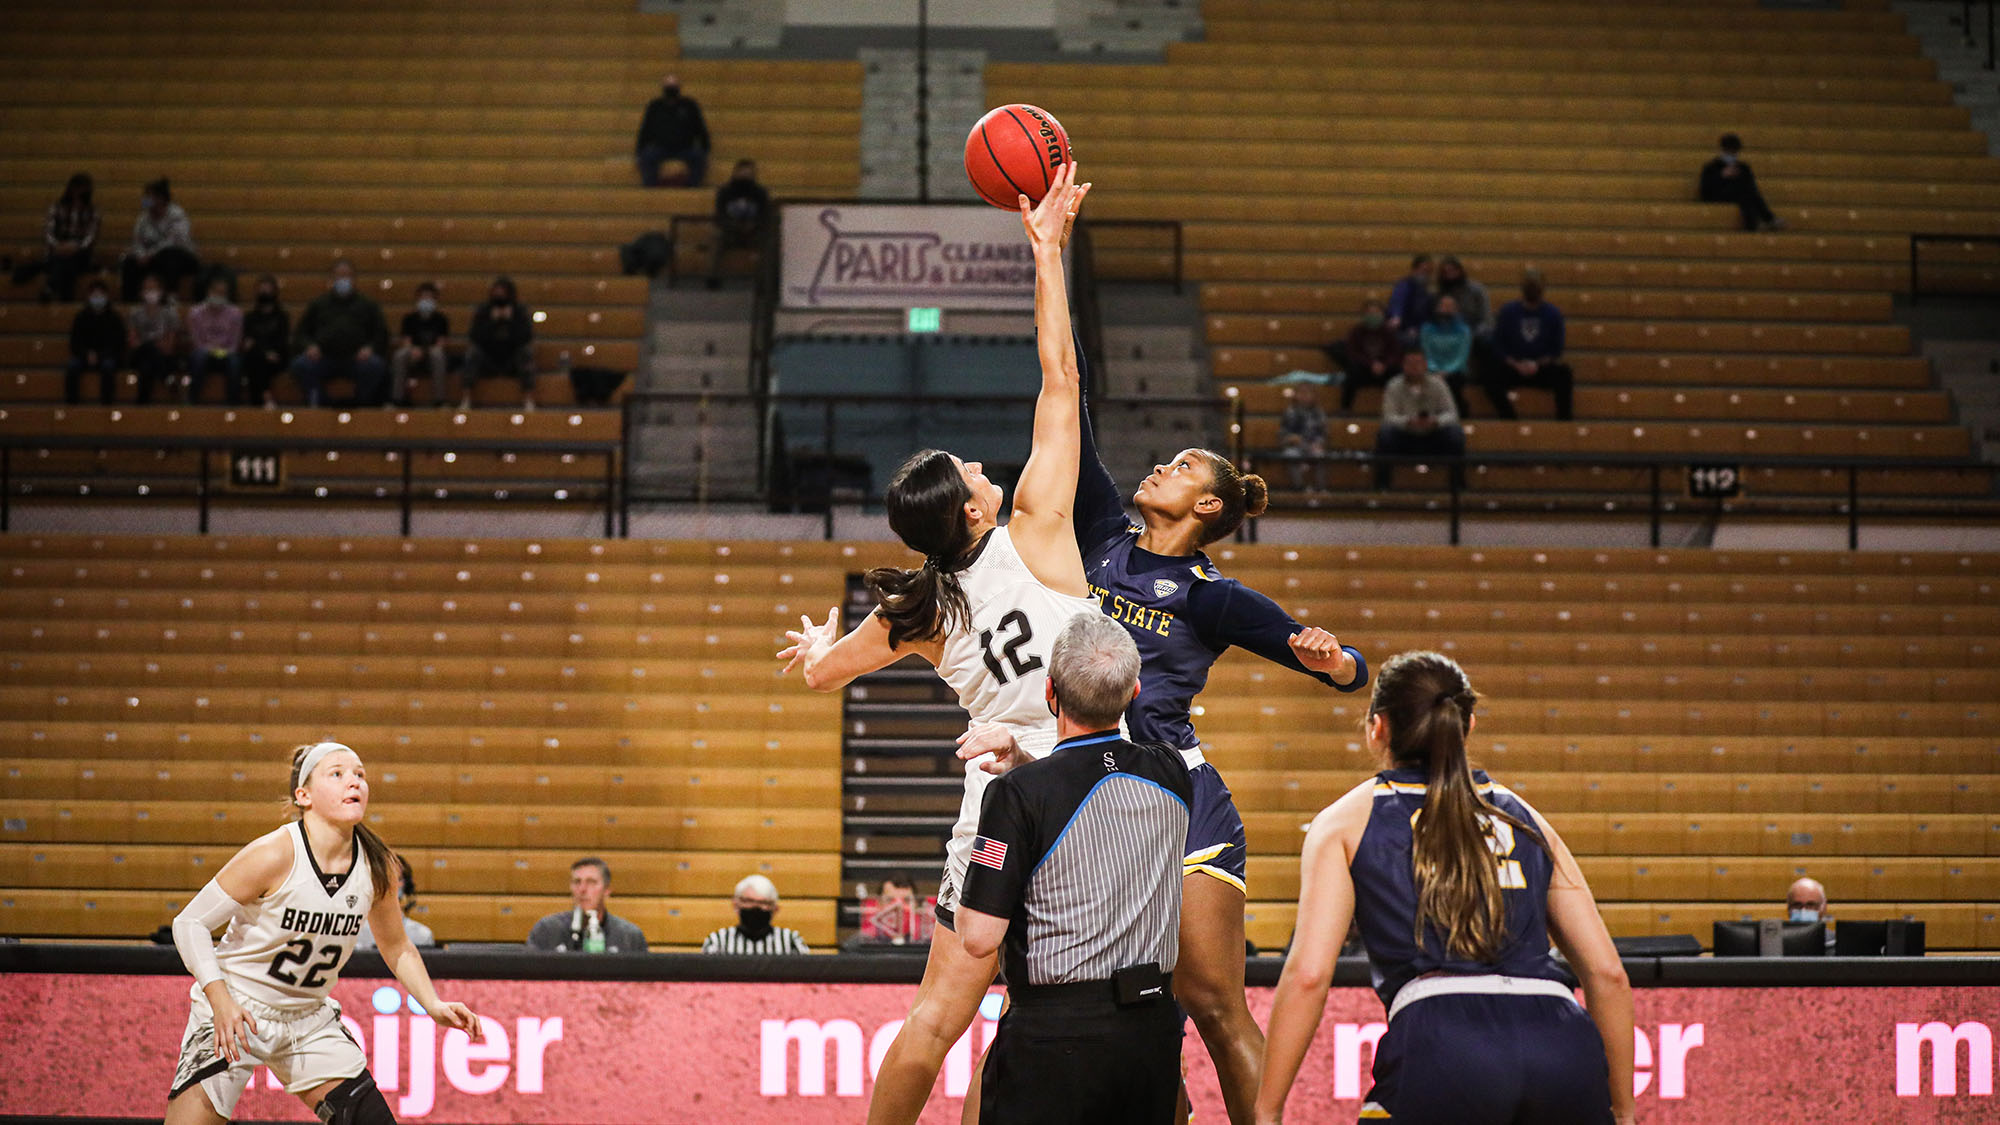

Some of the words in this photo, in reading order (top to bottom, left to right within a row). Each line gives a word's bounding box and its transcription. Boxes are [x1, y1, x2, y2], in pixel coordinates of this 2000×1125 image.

[1021, 106, 1062, 169] Wilson
[238, 456, 276, 481] 111
[1112, 595, 1175, 637] STATE
[980, 609, 1043, 686] 12
[281, 907, 363, 937] BRONCOS
[267, 938, 343, 988] 22
